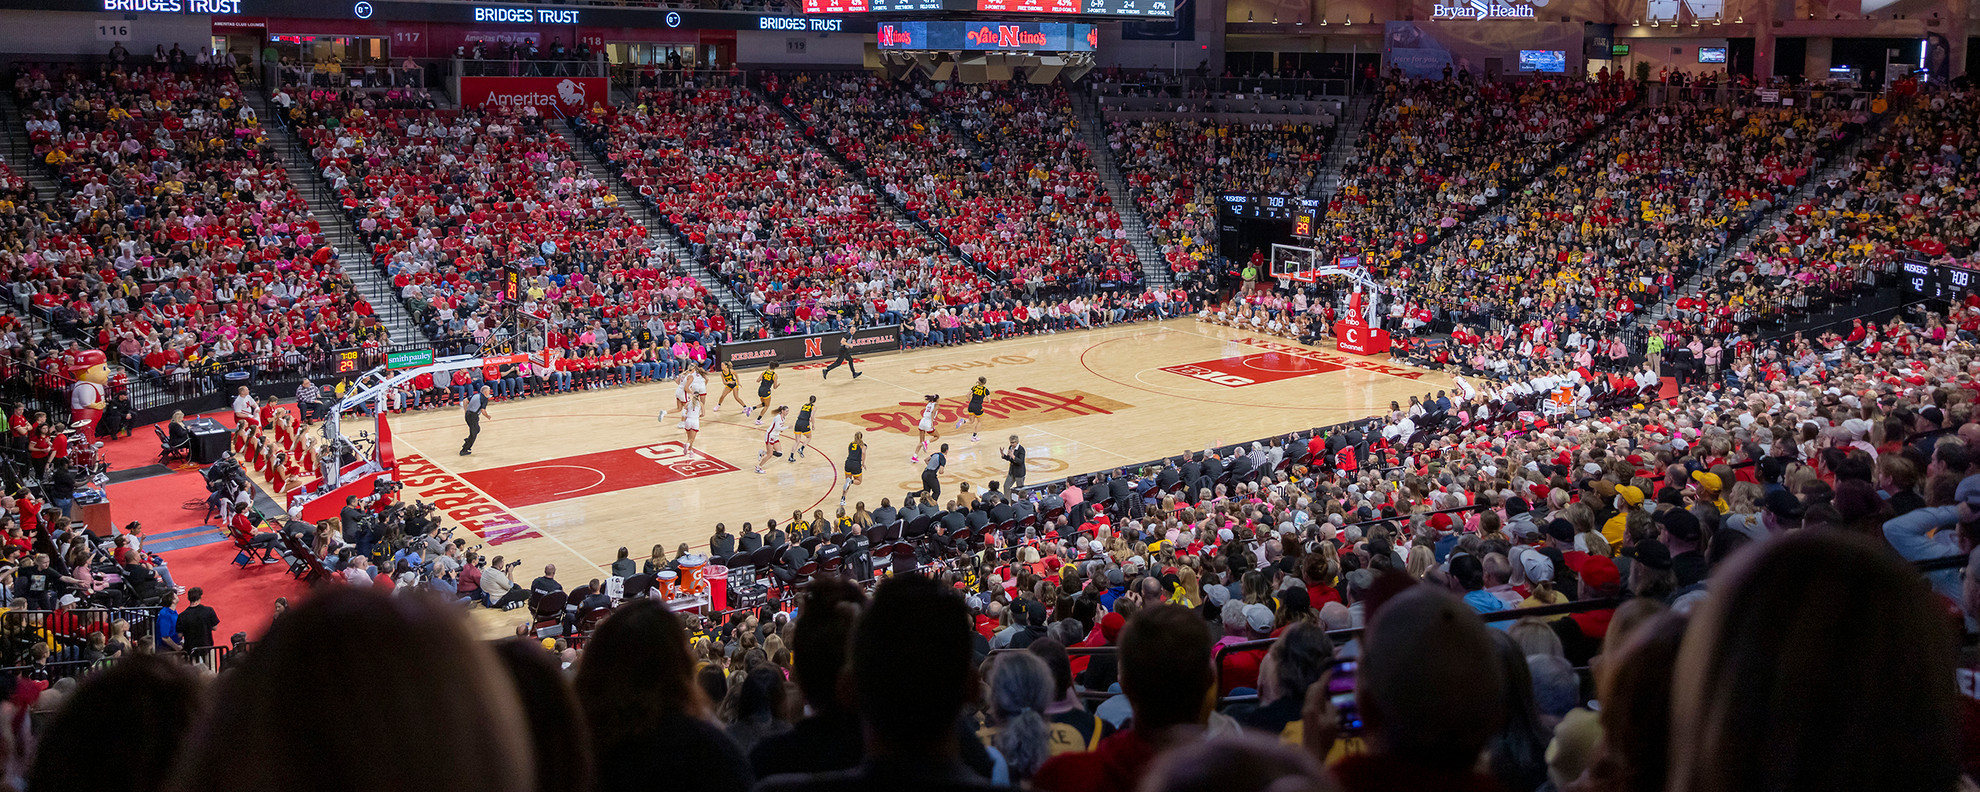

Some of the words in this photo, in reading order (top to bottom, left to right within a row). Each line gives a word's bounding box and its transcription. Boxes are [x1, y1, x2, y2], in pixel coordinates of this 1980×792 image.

[104, 0, 181, 12] BRIDGES
[189, 0, 241, 14] TRUST
[1433, 4, 1476, 20] Bryan
[1489, 4, 1534, 18] Health
[475, 8, 533, 22] BRIDGES
[538, 10, 579, 24] TRUST
[760, 17, 806, 30] BRIDGES
[809, 18, 842, 32] TRUST
[99, 26, 128, 36] 116
[396, 32, 420, 42] 117
[788, 42, 805, 50] 119
[486, 91, 557, 106] Ameritas
[1267, 196, 1284, 207] 7:08
[1231, 204, 1242, 214] 42
[1300, 216, 1310, 224] 7:08
[1296, 222, 1308, 234] 29
[1904, 262, 1928, 275] HUSKERS
[1912, 277, 1924, 292] 42
[1950, 270, 1968, 287] 7:08
[851, 334, 894, 347] ASKETBALL
[804, 337, 822, 358] N
[1340, 342, 1364, 352] Channel
[340, 351, 358, 360] 7:08
[731, 349, 776, 362] NEBRASKA
[340, 360, 354, 372] 29
[763, 373, 774, 382] 45
[974, 388, 984, 396] 20
[397, 454, 544, 546] NEBRASKA
[693, 570, 702, 580] G
[668, 582, 674, 590] G
